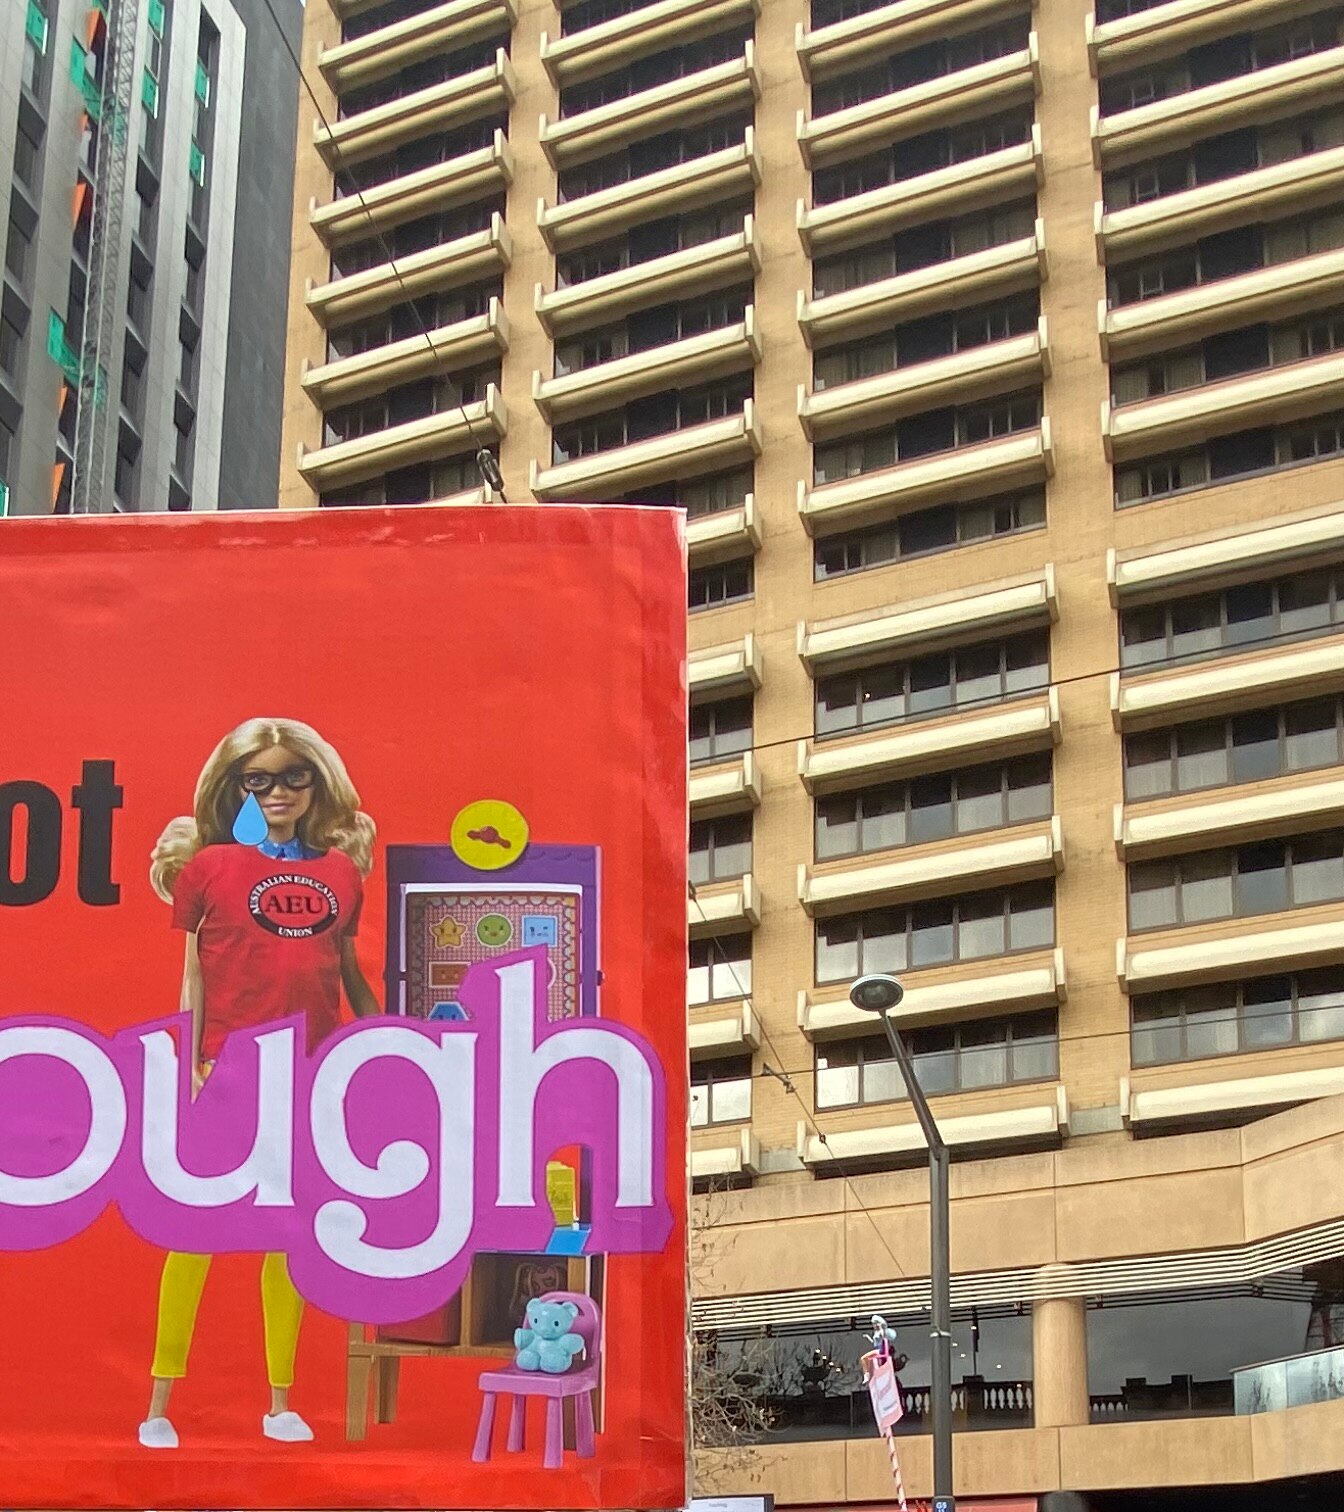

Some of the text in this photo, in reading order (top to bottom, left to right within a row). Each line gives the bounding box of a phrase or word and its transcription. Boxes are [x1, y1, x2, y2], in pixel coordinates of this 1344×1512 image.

[249, 875, 338, 916] AUSTRALIAN EDUCATION
[265, 895, 324, 914] AEU
[278, 926, 313, 937] UNION
